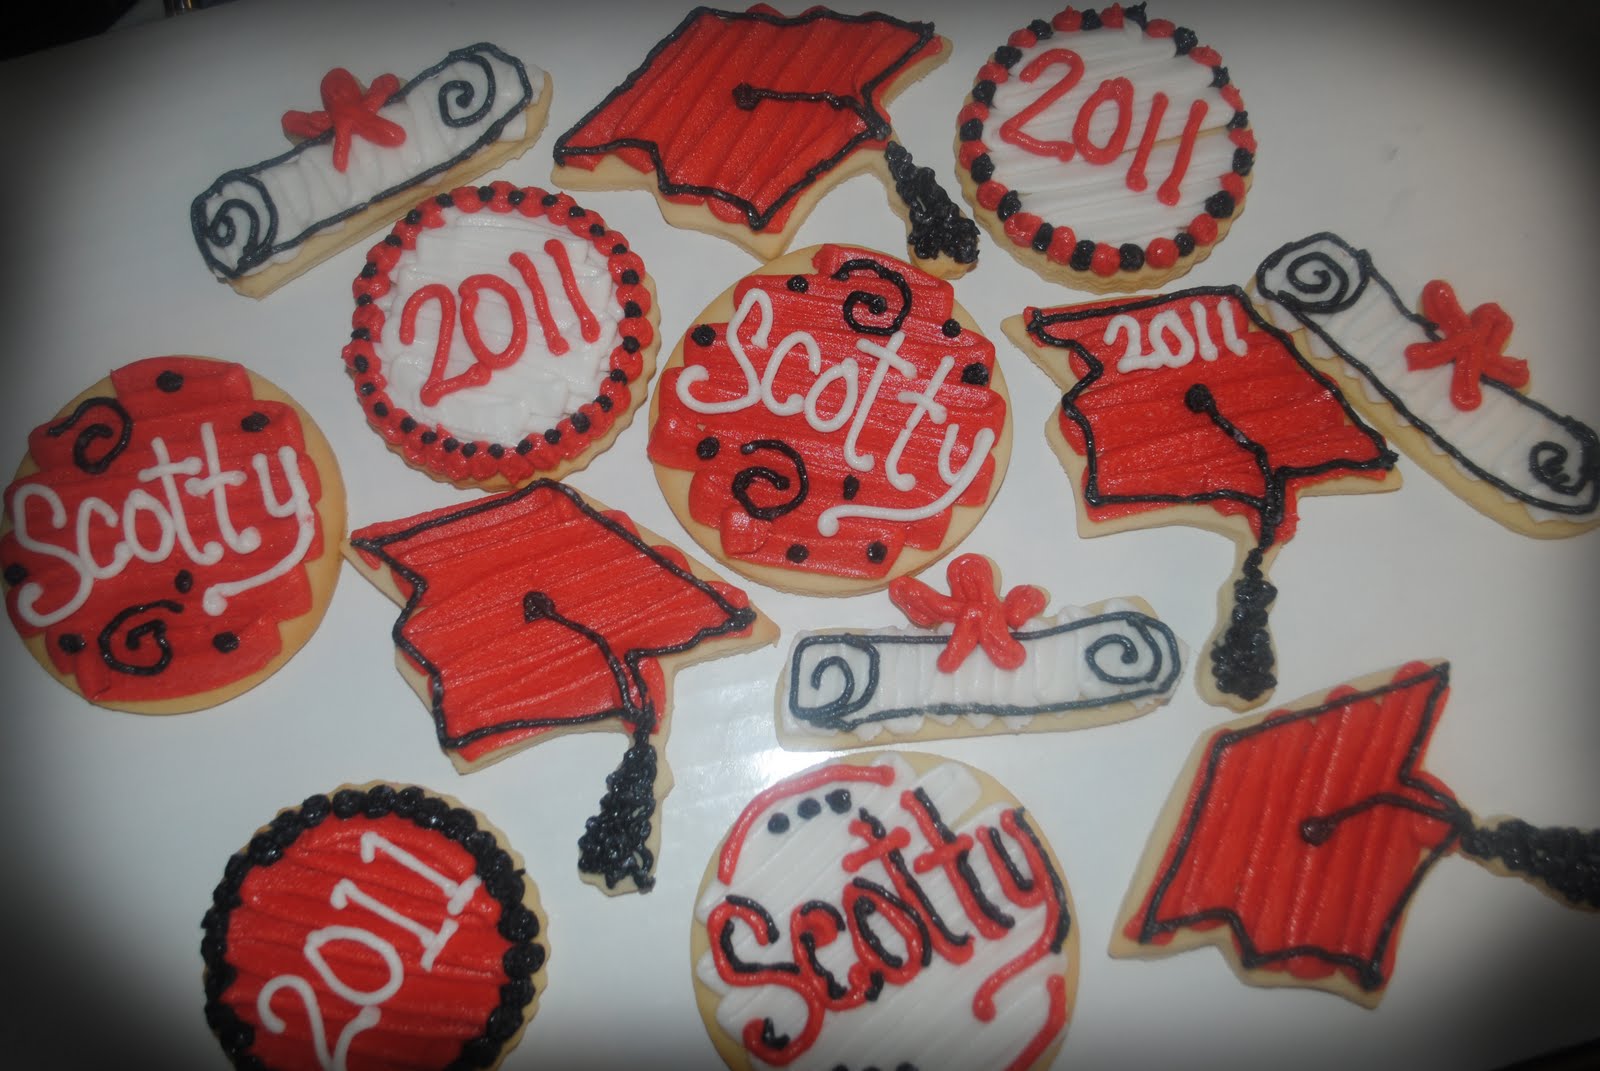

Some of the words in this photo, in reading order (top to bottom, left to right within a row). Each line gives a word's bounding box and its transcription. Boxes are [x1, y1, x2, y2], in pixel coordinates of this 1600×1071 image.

[1001, 48, 1209, 206] 2011
[399, 239, 600, 407] 2011
[677, 288, 995, 537] Scotty
[1105, 296, 1248, 373] 2011
[12, 422, 315, 628] Scotty
[257, 831, 483, 1071] 2011
[706, 787, 1070, 1067] Scotty
